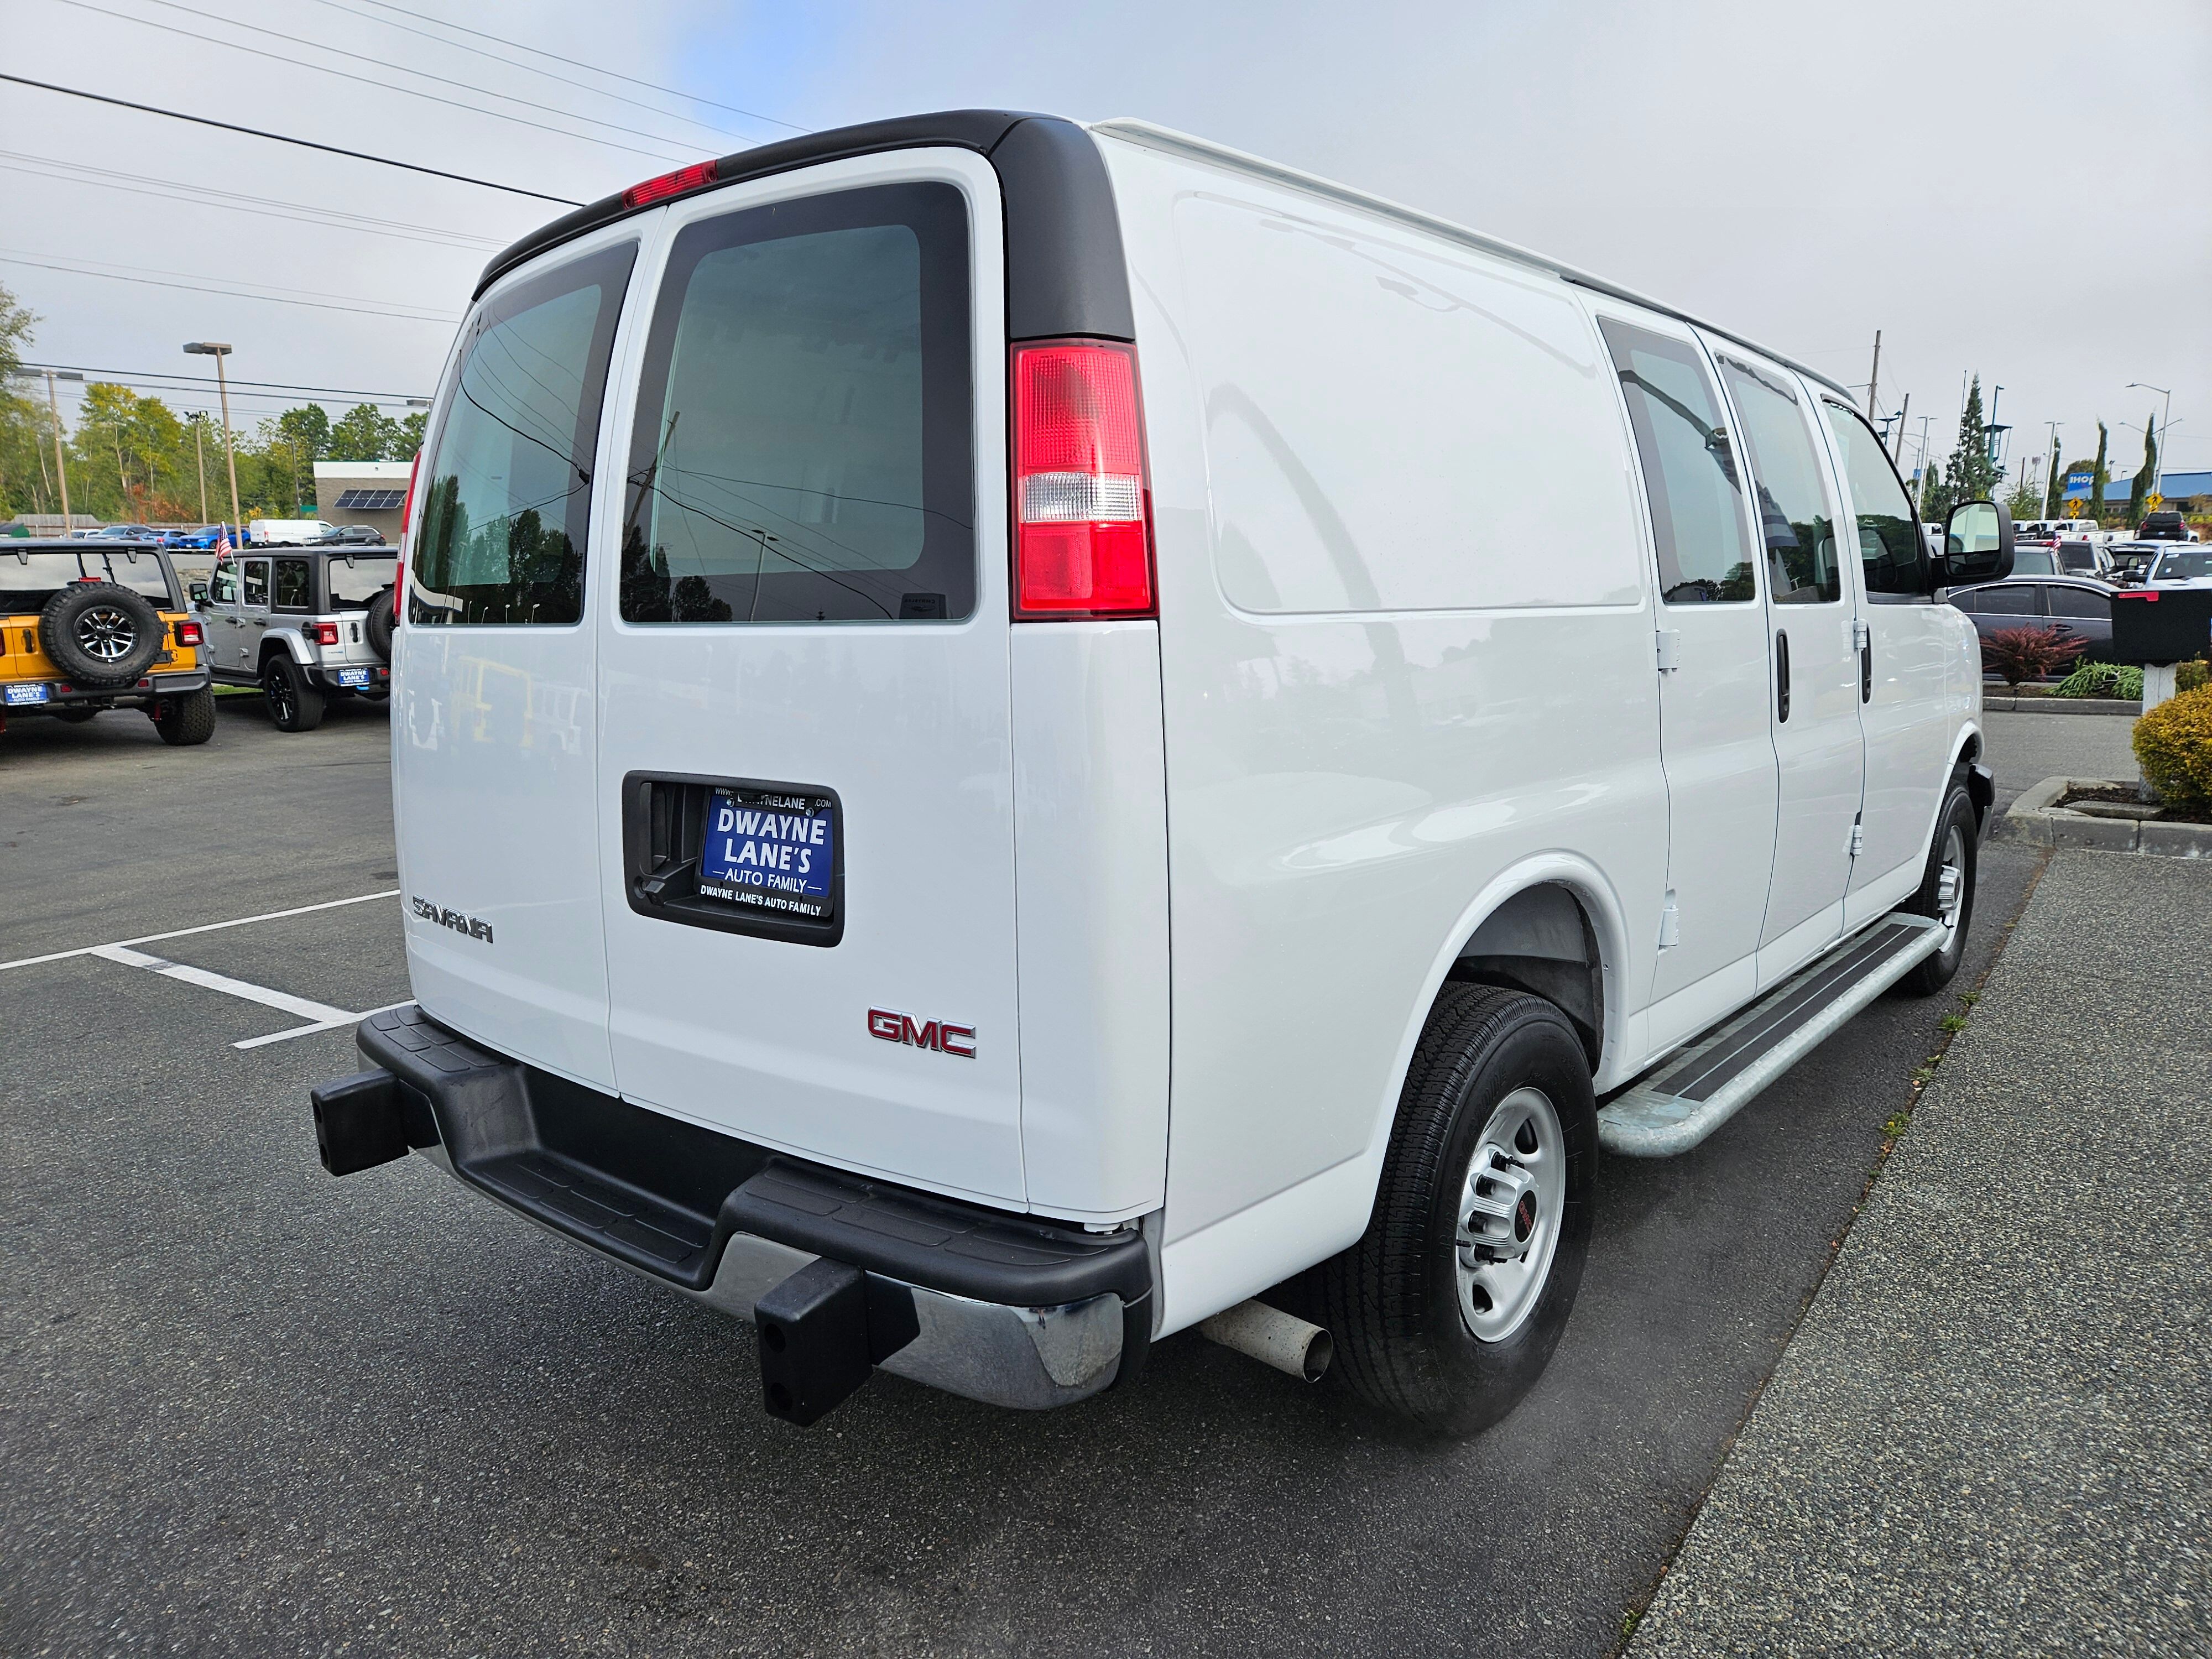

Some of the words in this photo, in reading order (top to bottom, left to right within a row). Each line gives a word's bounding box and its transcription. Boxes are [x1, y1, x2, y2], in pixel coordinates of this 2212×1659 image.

[7, 686, 43, 695] DWAYNE
[717, 808, 827, 845] DWAYNE
[724, 838, 812, 874] LANE'S
[724, 868, 763, 885] AUTO
[767, 874, 807, 893] FAMILY
[700, 885, 733, 900] DWAYNE
[735, 891, 763, 905] LANE'S
[764, 897, 787, 910] AUTO
[789, 901, 822, 916] FAMILY
[412, 894, 494, 944] SAVANA
[867, 1005, 977, 1060] GMC
[1518, 1200, 1533, 1234] GMC
